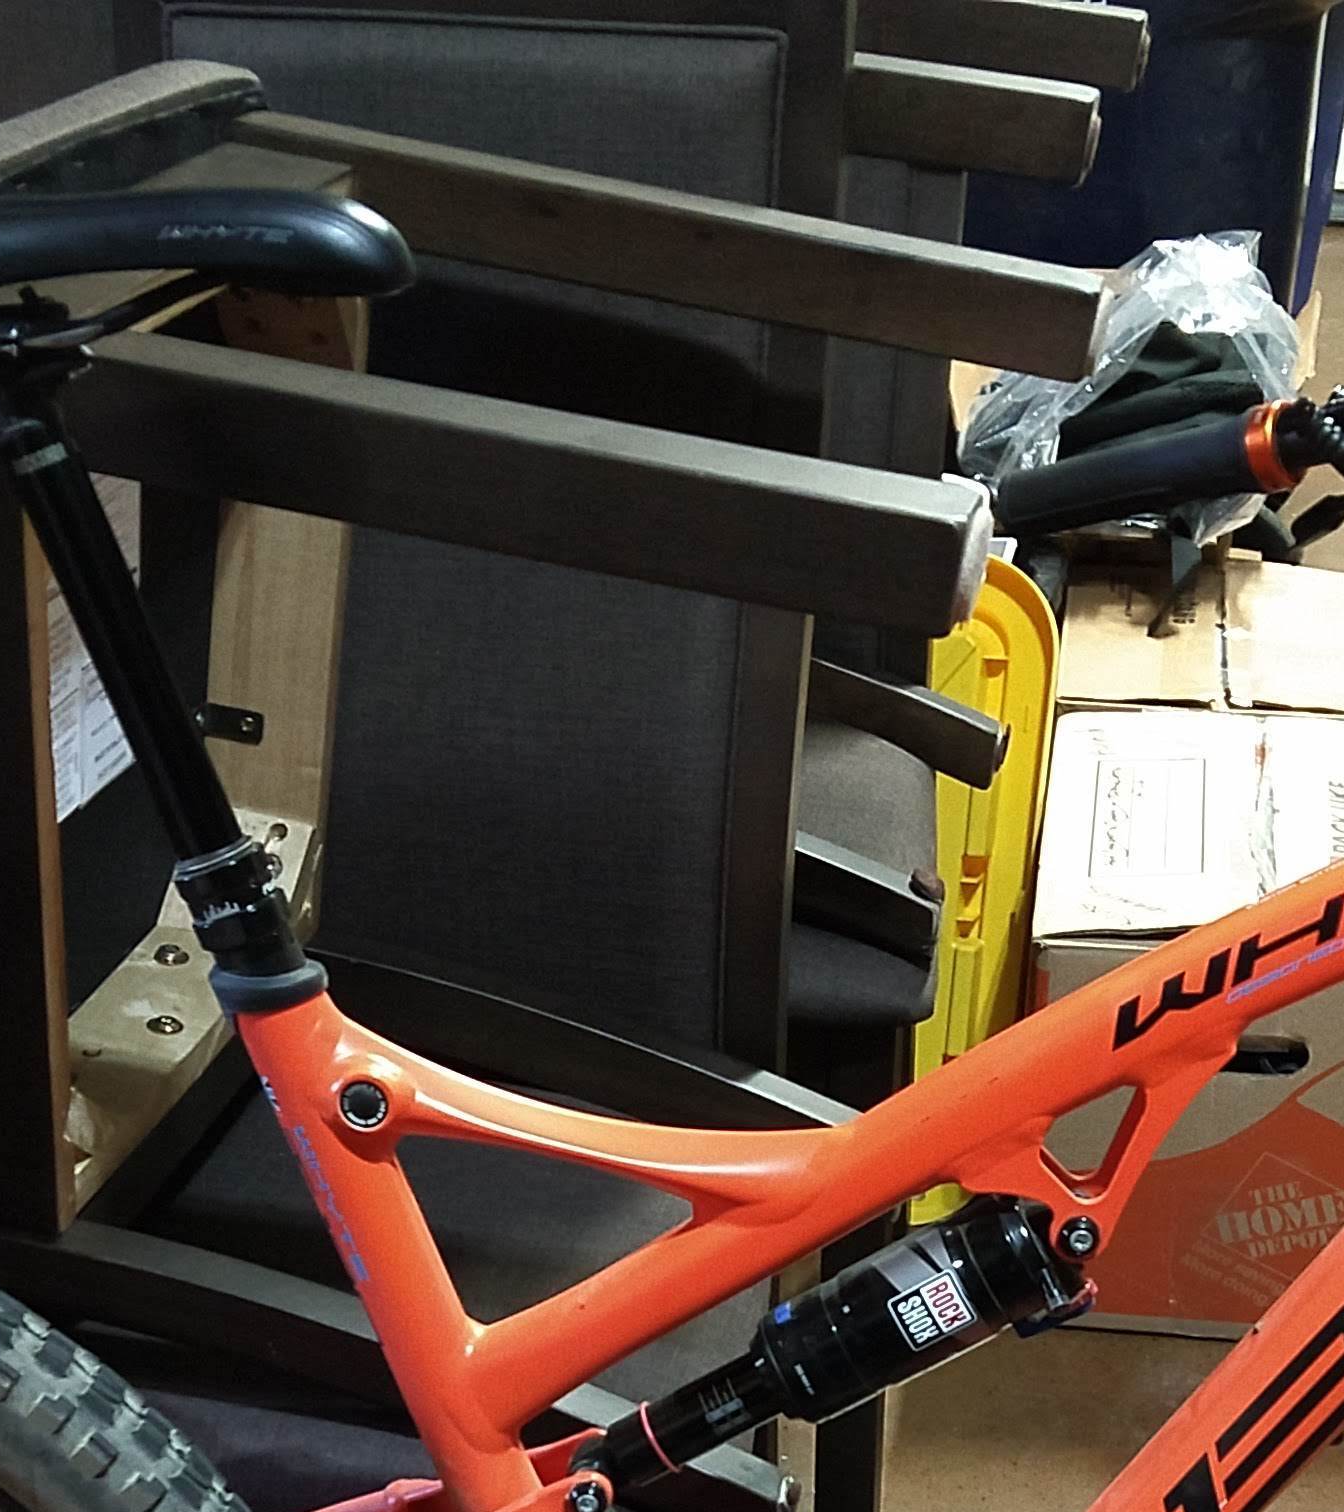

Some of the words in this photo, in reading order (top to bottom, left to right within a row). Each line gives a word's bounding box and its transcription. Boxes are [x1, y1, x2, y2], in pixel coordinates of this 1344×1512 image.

[1249, 1180, 1304, 1205] THE
[1245, 1225, 1334, 1259] DEPOT
[895, 1294, 941, 1347] SHOX
[925, 1278, 970, 1333] ROCK
